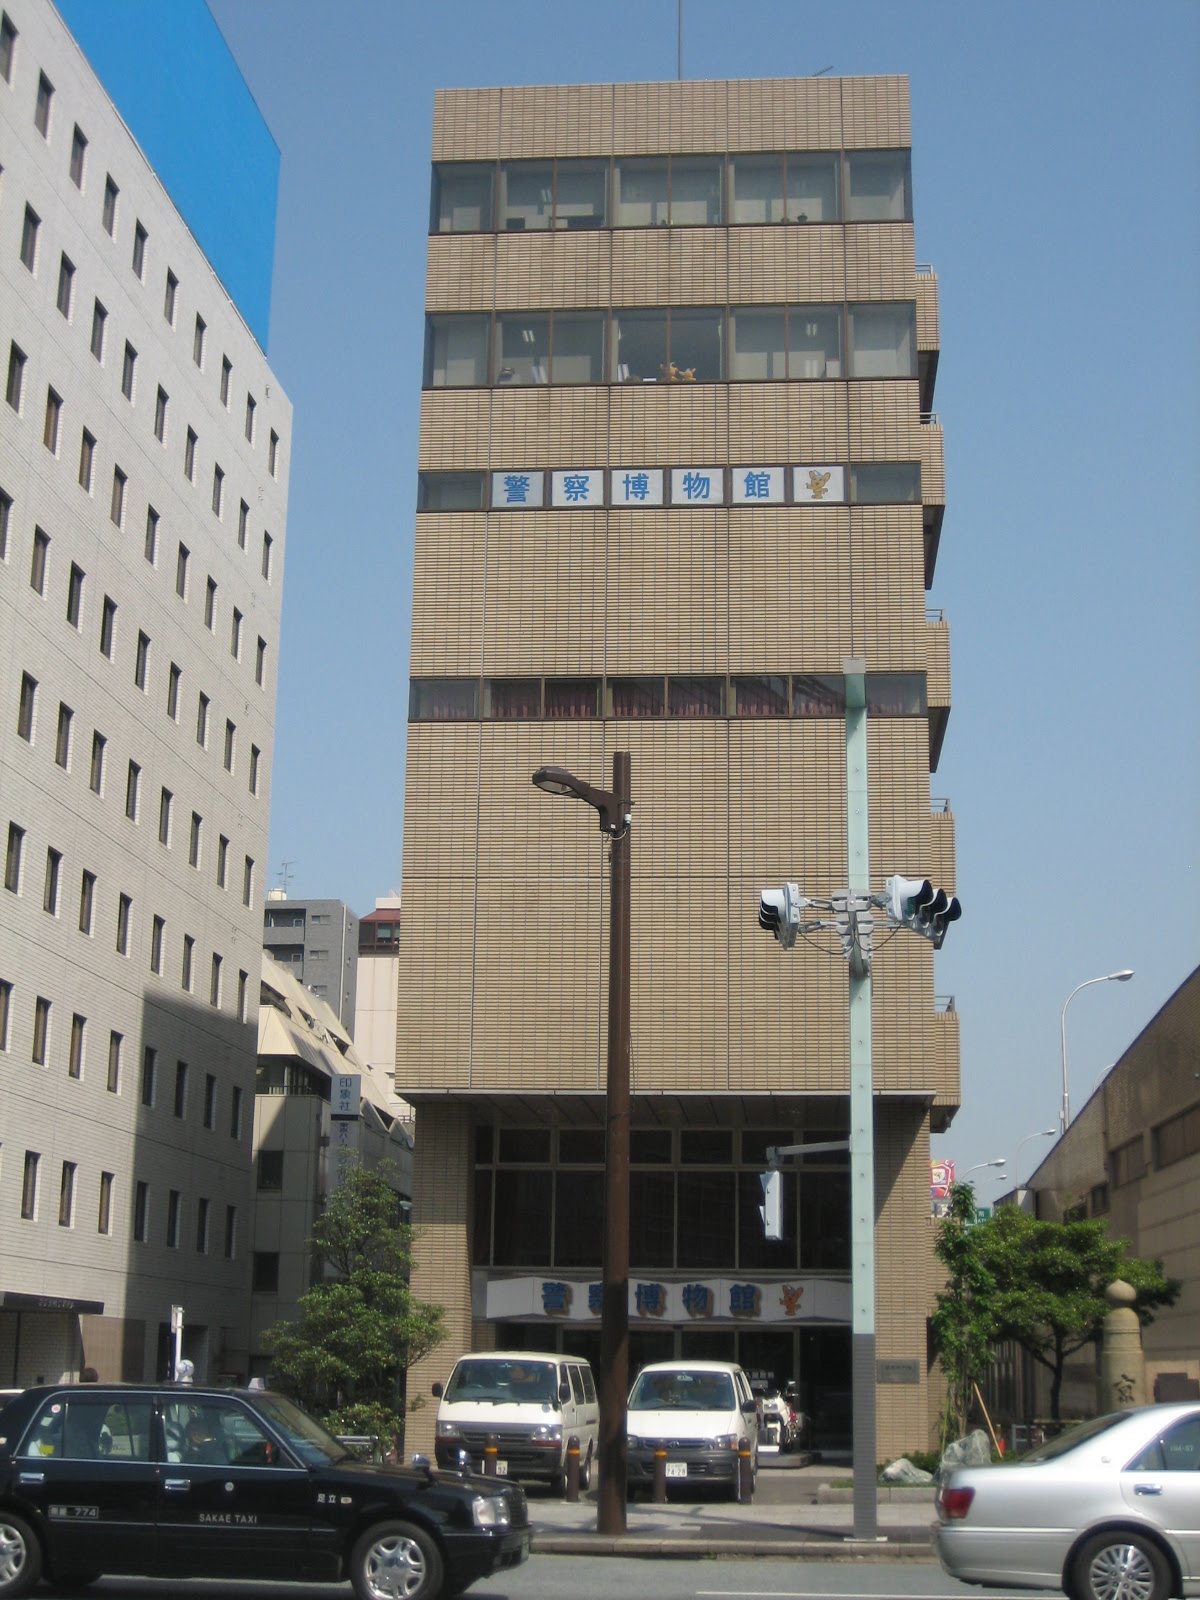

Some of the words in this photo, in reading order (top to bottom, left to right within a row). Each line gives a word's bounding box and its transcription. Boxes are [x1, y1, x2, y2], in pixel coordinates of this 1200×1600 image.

[503, 471, 771, 503] 警察博物館
[199, 1513, 231, 1523] SAKAE
[235, 1514, 258, 1524] TAXI
